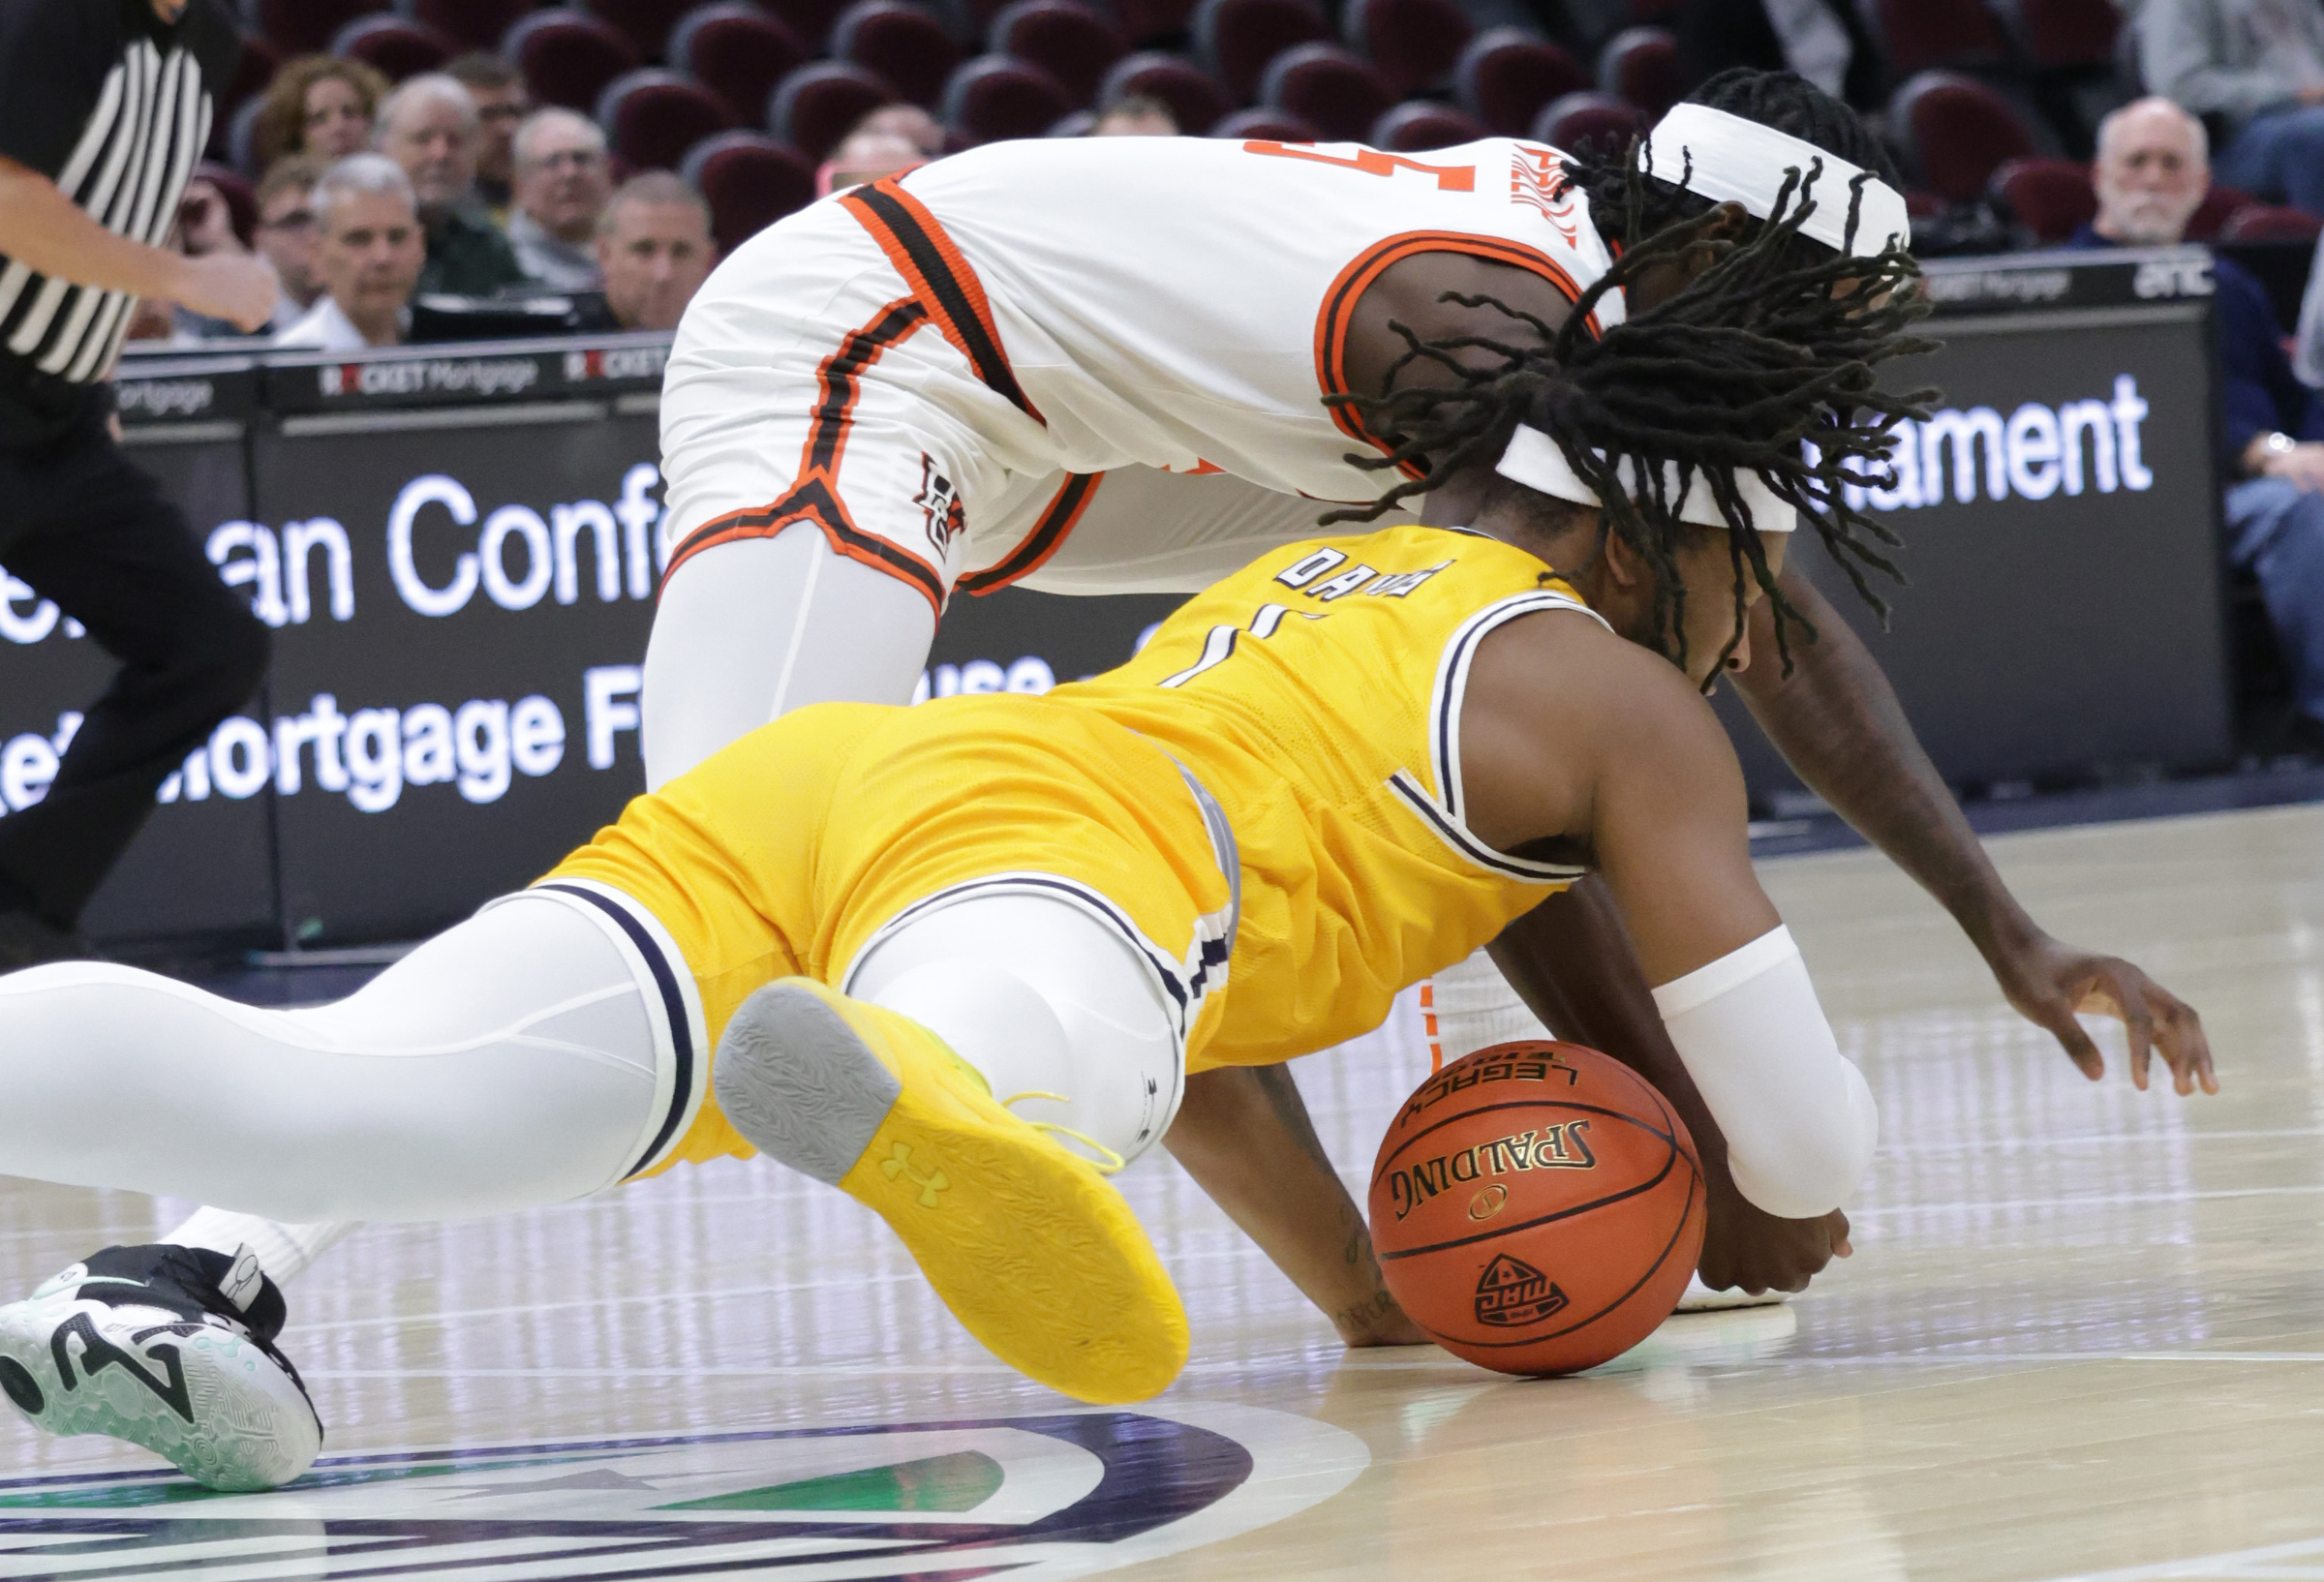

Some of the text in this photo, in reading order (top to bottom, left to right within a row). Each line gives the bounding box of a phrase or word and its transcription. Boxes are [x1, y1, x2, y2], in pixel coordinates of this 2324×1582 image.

[118, 380, 213, 416] ortgage
[157, 692, 567, 813] ortgage
[1390, 1118, 1597, 1222] SPALDING
